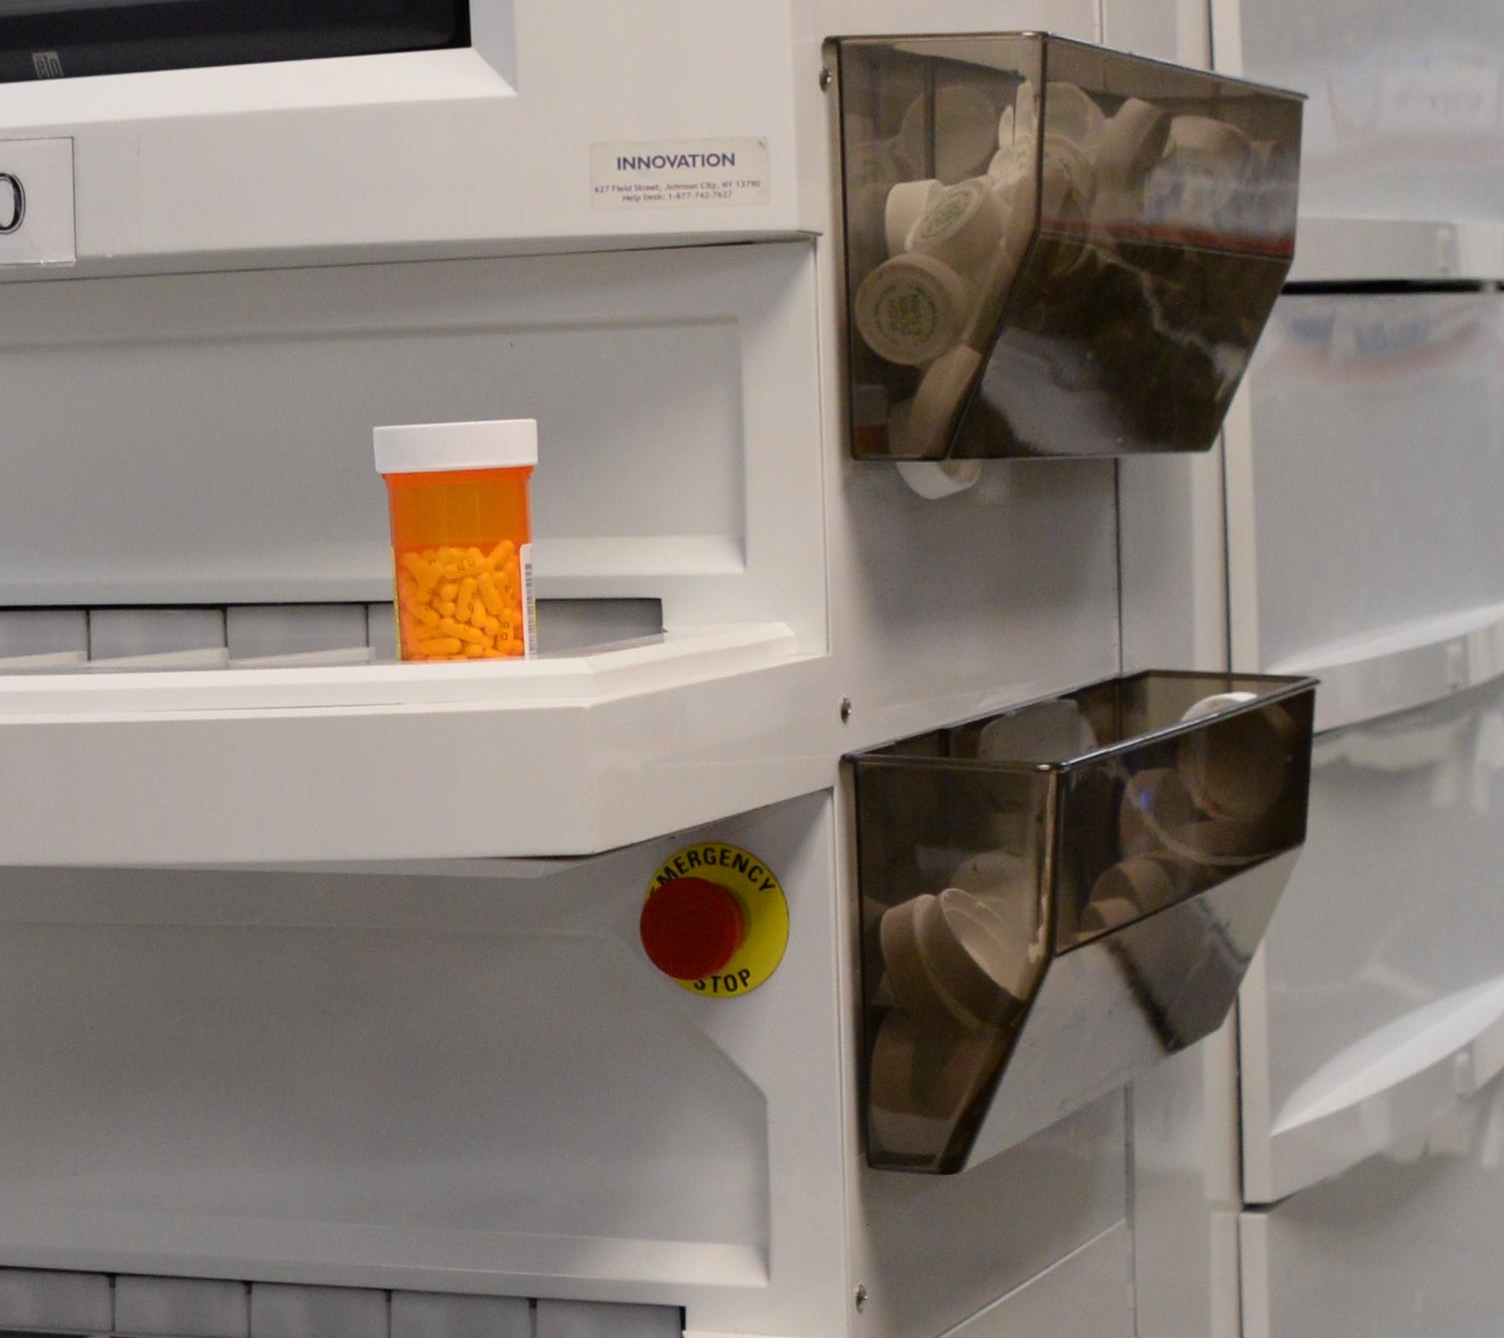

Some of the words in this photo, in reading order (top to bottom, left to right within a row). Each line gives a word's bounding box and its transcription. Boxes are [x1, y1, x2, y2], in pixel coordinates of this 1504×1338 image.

[617, 153, 736, 171] INNOVATION
[622, 193, 641, 203] Help
[650, 847, 776, 896] MERGENCY
